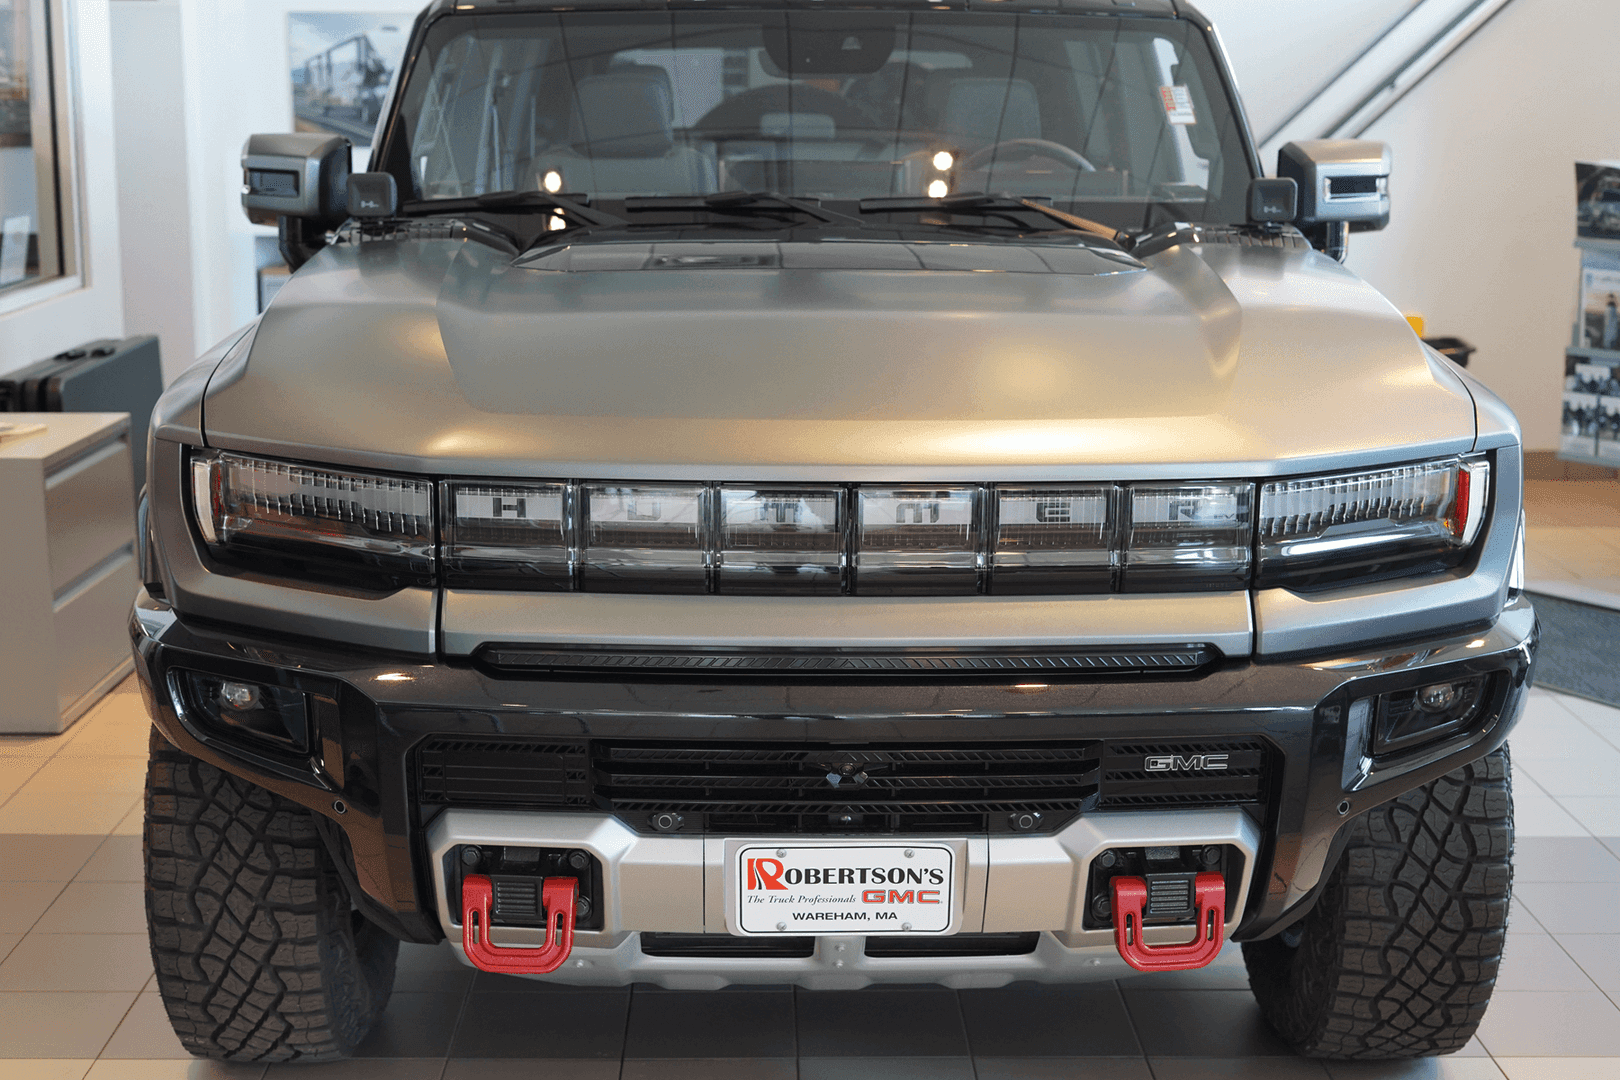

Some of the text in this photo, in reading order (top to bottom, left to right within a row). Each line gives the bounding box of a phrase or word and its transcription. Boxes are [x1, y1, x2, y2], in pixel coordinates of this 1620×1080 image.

[1145, 754, 1229, 772] GMC
[747, 858, 945, 890] ROBERTSON'S
[747, 894, 857, 906] The Truck Professionals
[862, 890, 941, 904] GMC
[792, 912, 898, 921] WAREHAM, MA
